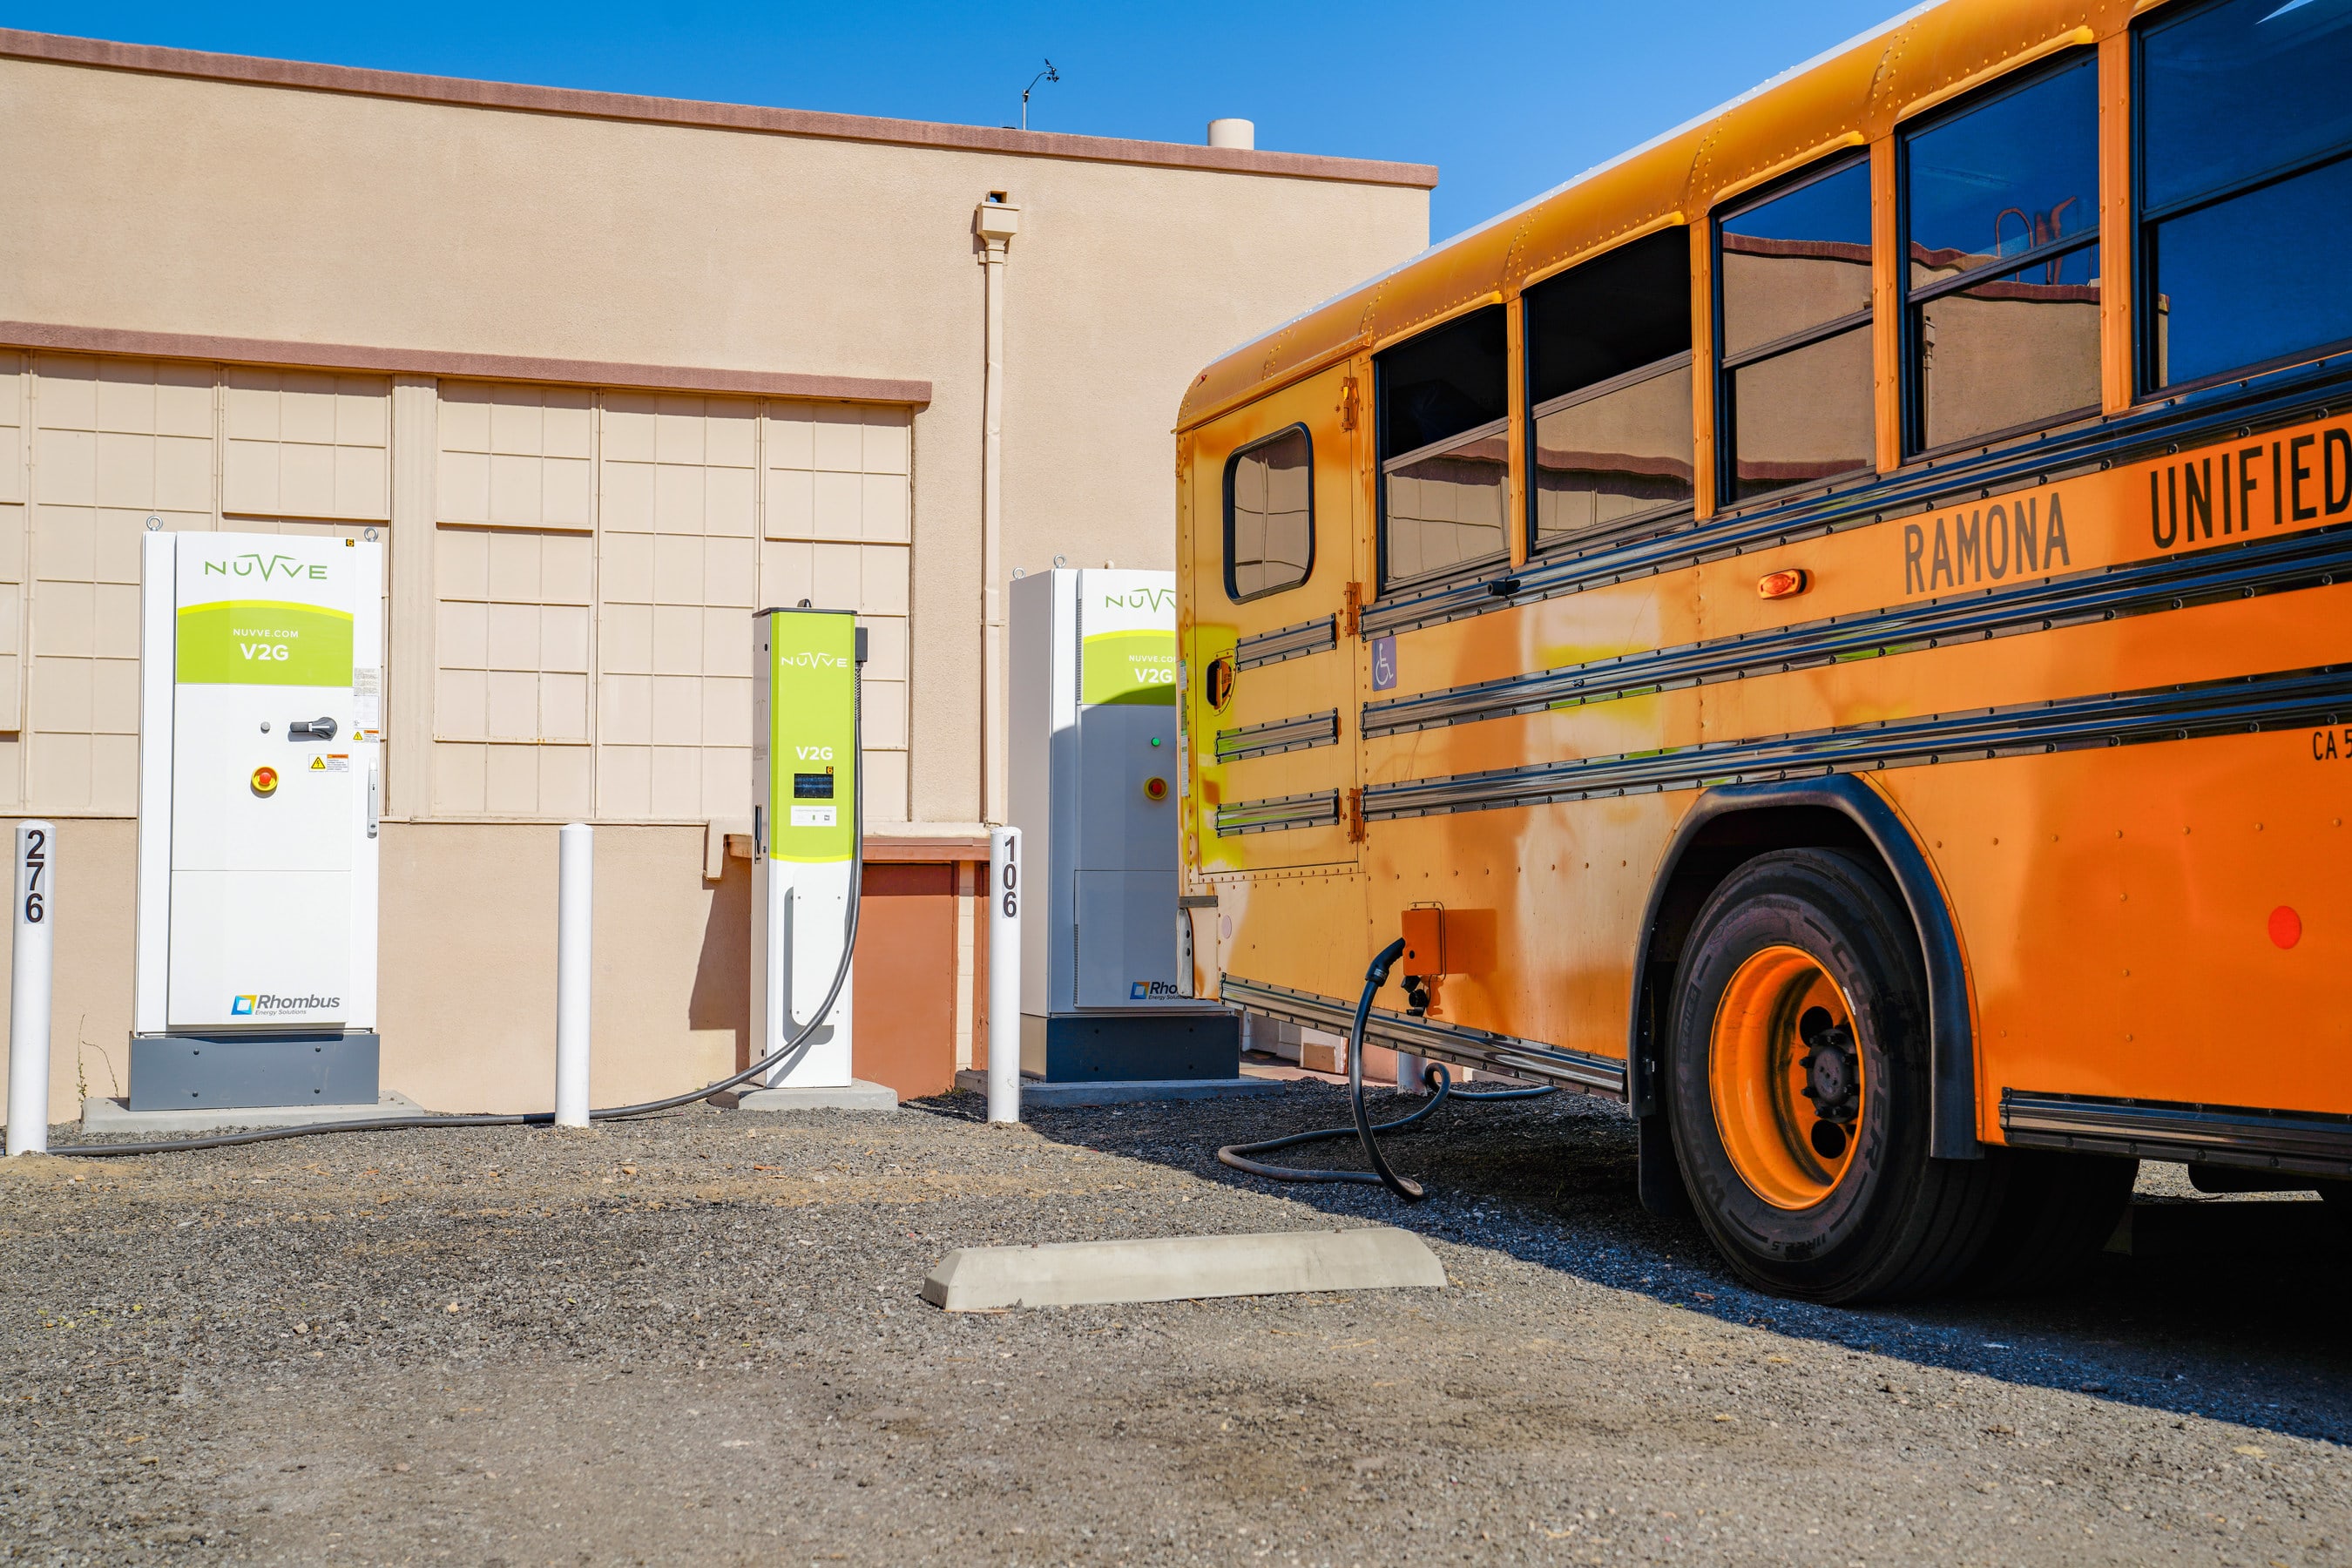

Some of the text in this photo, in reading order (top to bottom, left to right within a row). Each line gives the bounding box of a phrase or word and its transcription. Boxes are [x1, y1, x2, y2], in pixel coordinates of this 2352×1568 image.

[1905, 427, 2352, 595] RAMONA UNIFIED
[205, 553, 328, 582] NUVVE
[1105, 588, 1176, 613] NUV
[233, 628, 299, 638] NUVVE.COM
[240, 643, 289, 661] V2G
[781, 652, 848, 670] NUVVE
[1134, 668, 1173, 683] V2G
[795, 746, 834, 760] V2G
[2313, 730, 2337, 760] CA
[25, 829, 44, 924] 276
[1003, 836, 1017, 918] 106
[256, 994, 341, 1009] Rhombus
[1831, 941, 1888, 1171] COOPER
